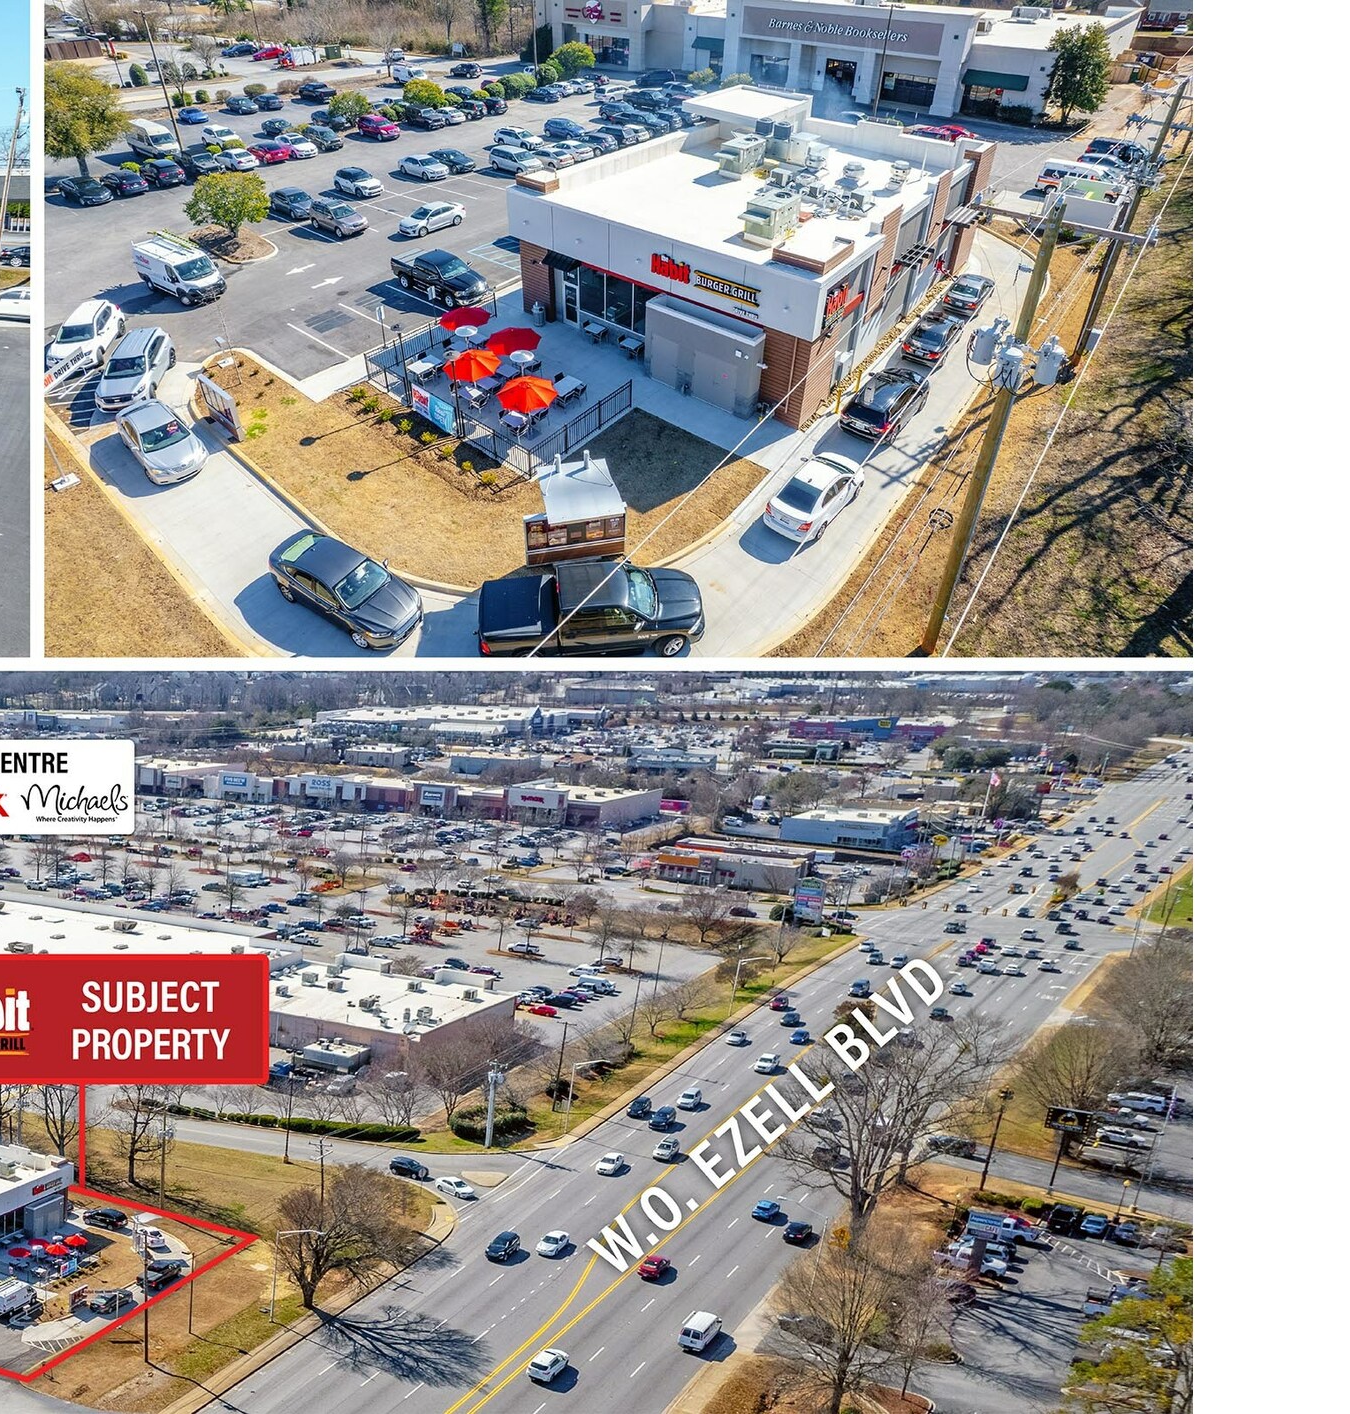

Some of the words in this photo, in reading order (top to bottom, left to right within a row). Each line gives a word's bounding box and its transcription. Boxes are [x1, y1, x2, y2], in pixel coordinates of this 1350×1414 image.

[768, 18, 803, 31] Barnes
[804, 20, 814, 33] &
[814, 22, 844, 36] Noble
[845, 26, 908, 43] Booksellers
[651, 253, 691, 285] Habit
[696, 275, 730, 296] BURGER
[731, 286, 757, 303] GRILL
[53, 362, 71, 379] DRIVE
[70, 351, 85, 366] THRU
